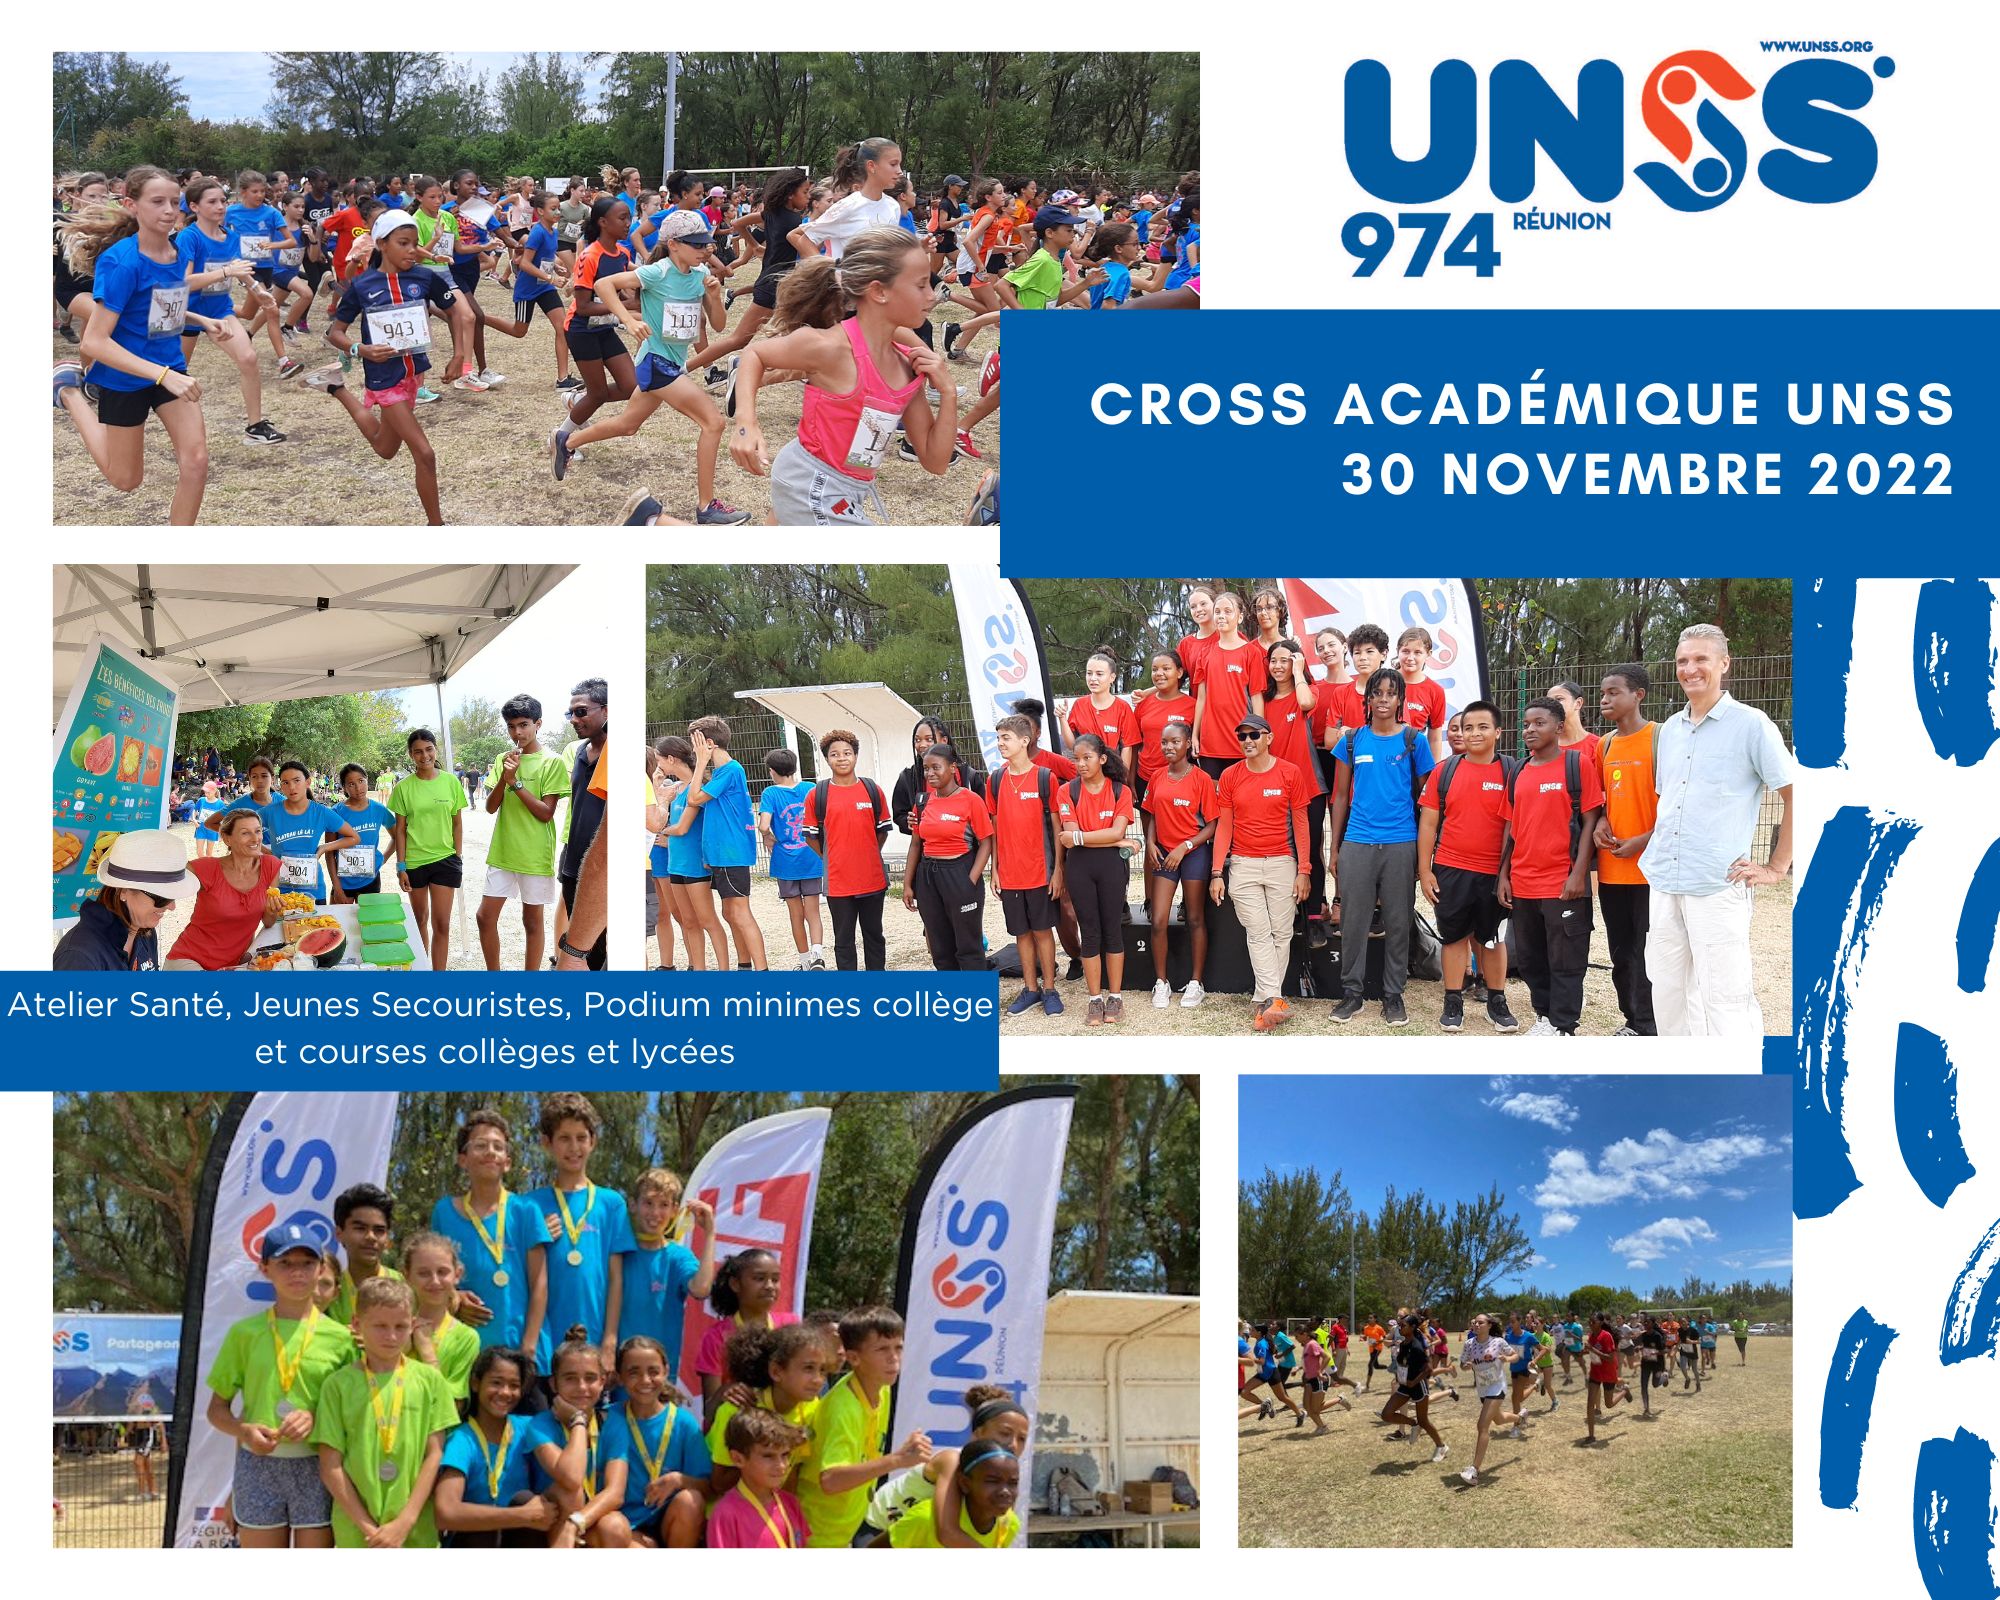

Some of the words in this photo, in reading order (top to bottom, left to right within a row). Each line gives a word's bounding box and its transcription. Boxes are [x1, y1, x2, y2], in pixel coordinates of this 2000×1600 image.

[161, 300, 182, 319] 397
[671, 314, 698, 329] 1133
[383, 320, 415, 340] 943
[114, 673, 146, 704] BÉNÉFICES
[275, 831, 297, 842] PLATEAU
[346, 856, 365, 867] 903
[288, 865, 308, 877] 904
[1136, 940, 1146, 952] 2
[1329, 951, 1340, 963] 3
